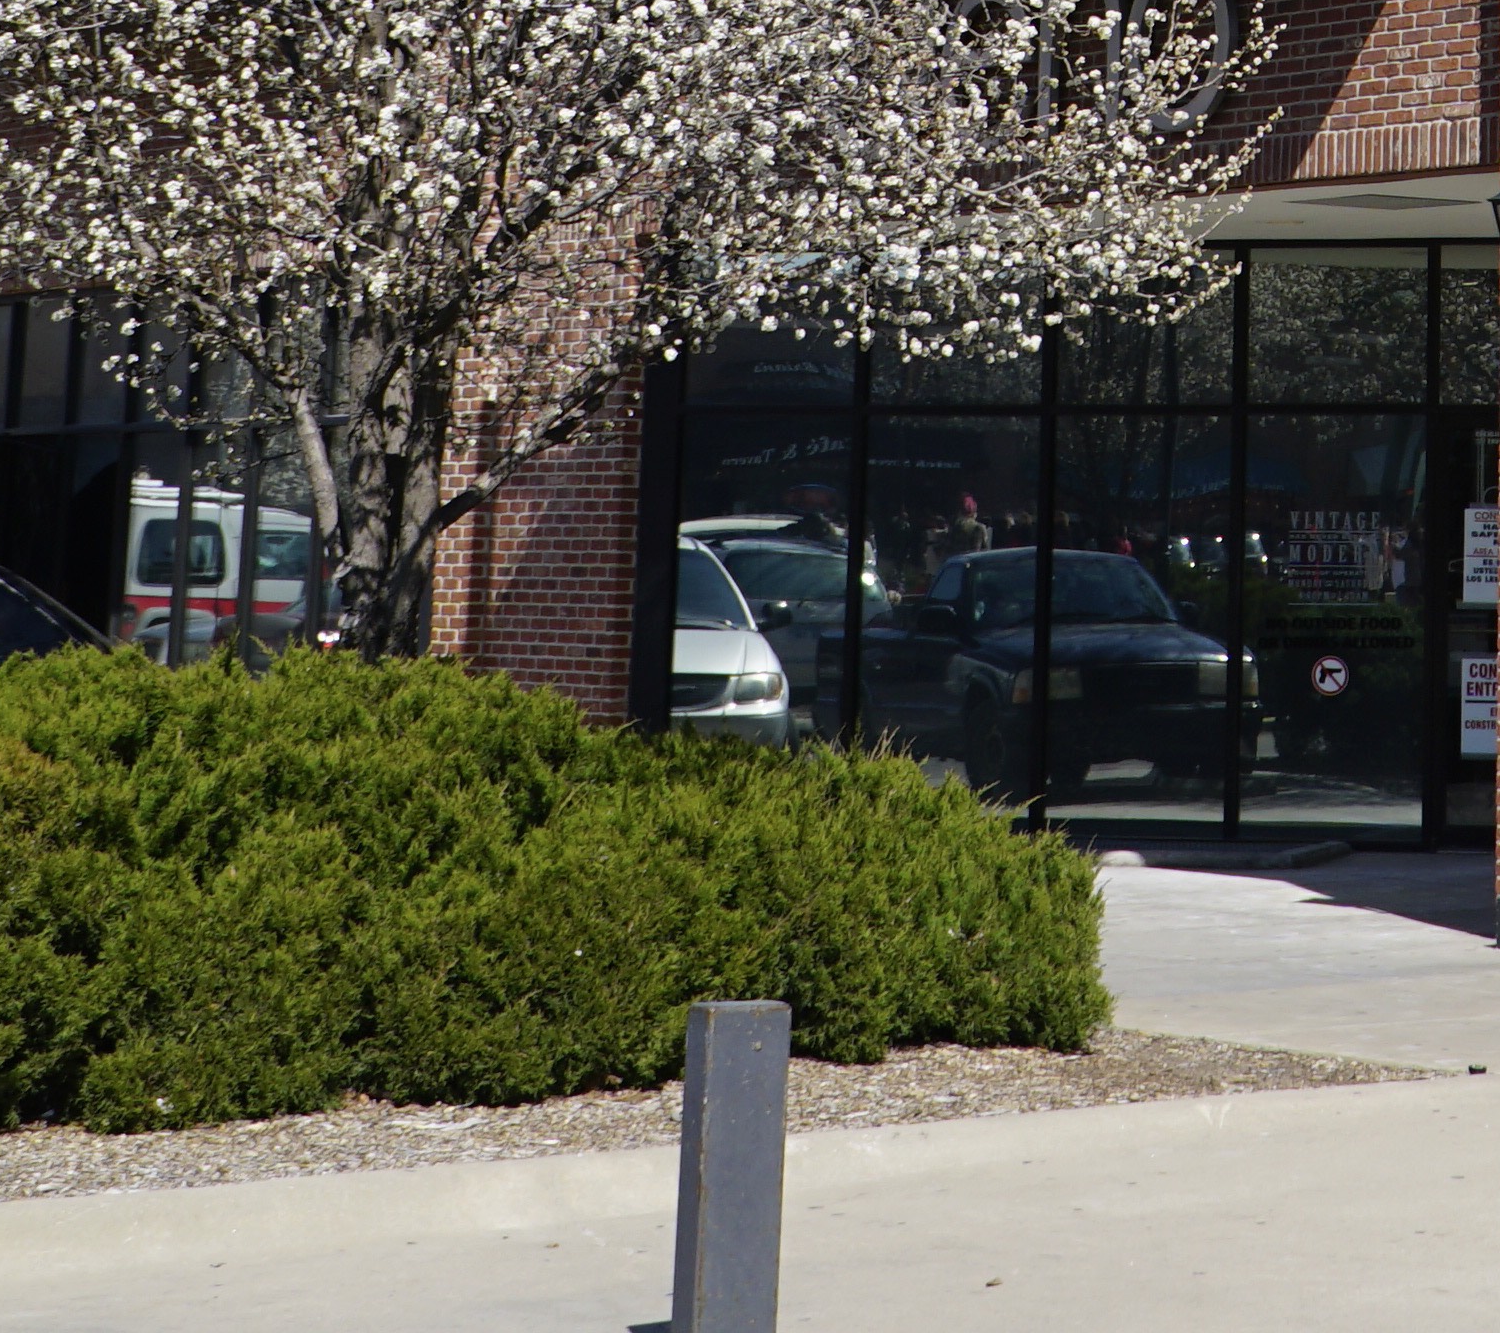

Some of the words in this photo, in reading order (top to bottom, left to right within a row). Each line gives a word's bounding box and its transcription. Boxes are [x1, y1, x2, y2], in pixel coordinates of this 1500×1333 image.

[1289, 511, 1382, 531] VINTAGE
[1289, 544, 1372, 563] MODER
[1292, 616, 1358, 631] OUTSIDE
[1360, 616, 1403, 631] FOOD
[1341, 636, 1415, 649] ALLOWED
